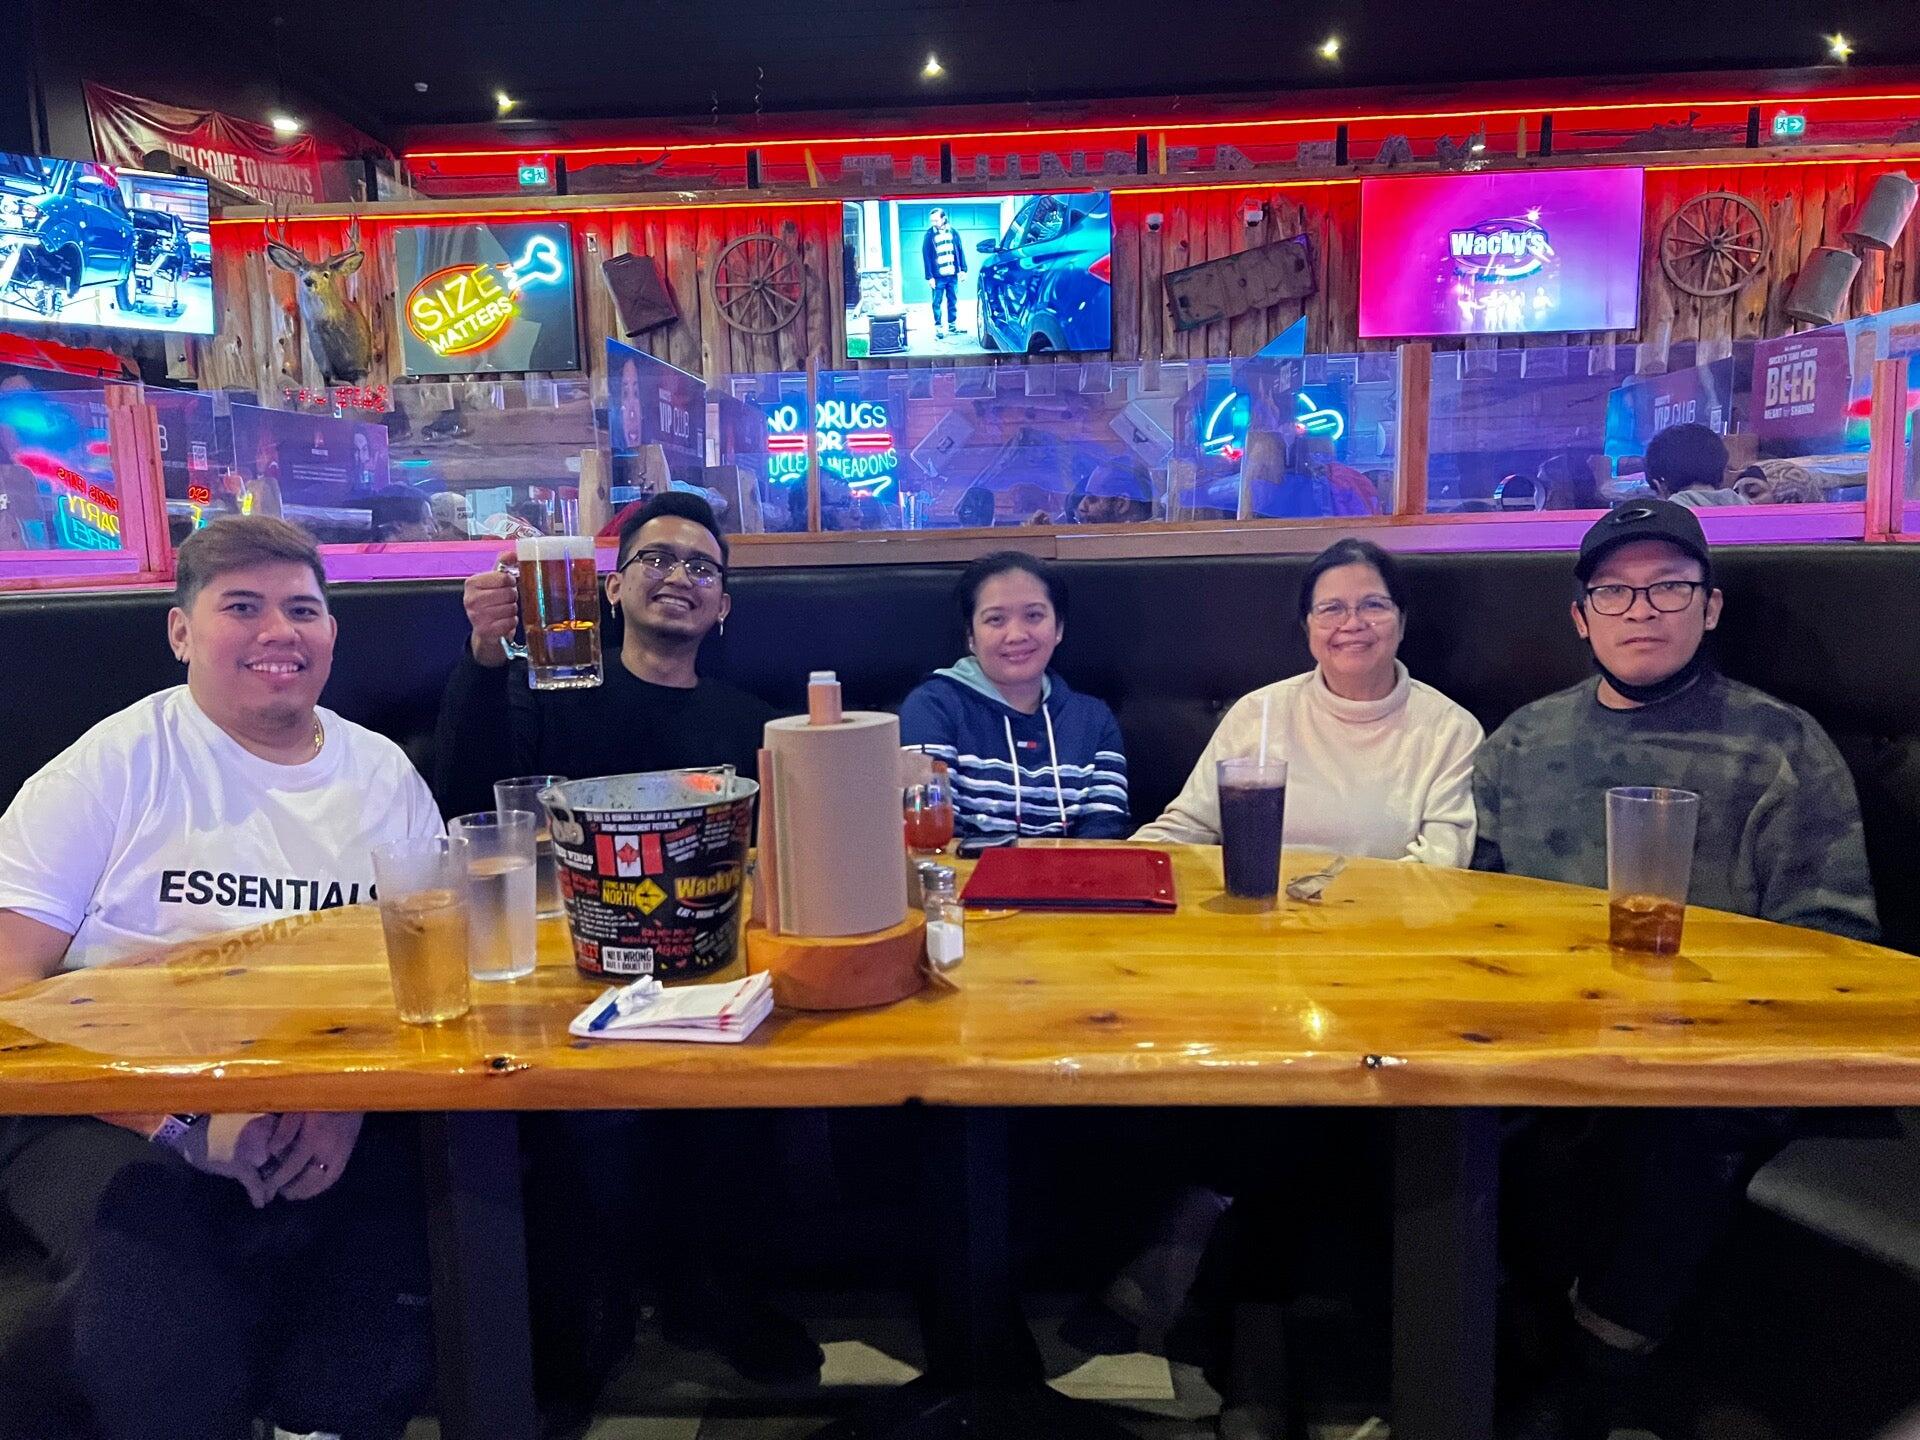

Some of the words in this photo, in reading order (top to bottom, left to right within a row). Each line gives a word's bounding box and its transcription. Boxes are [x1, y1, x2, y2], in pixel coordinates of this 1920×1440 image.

[166, 142, 241, 183] WELCOME
[240, 156, 258, 185] TO
[258, 160, 313, 193] WACKY'S
[1450, 230, 1546, 257] Wacky's
[412, 263, 503, 332] SIZE
[427, 296, 513, 357] MATTERS
[1765, 360, 1818, 407] BEER
[602, 888, 636, 907] NORTH
[623, 950, 652, 962] WRONG
